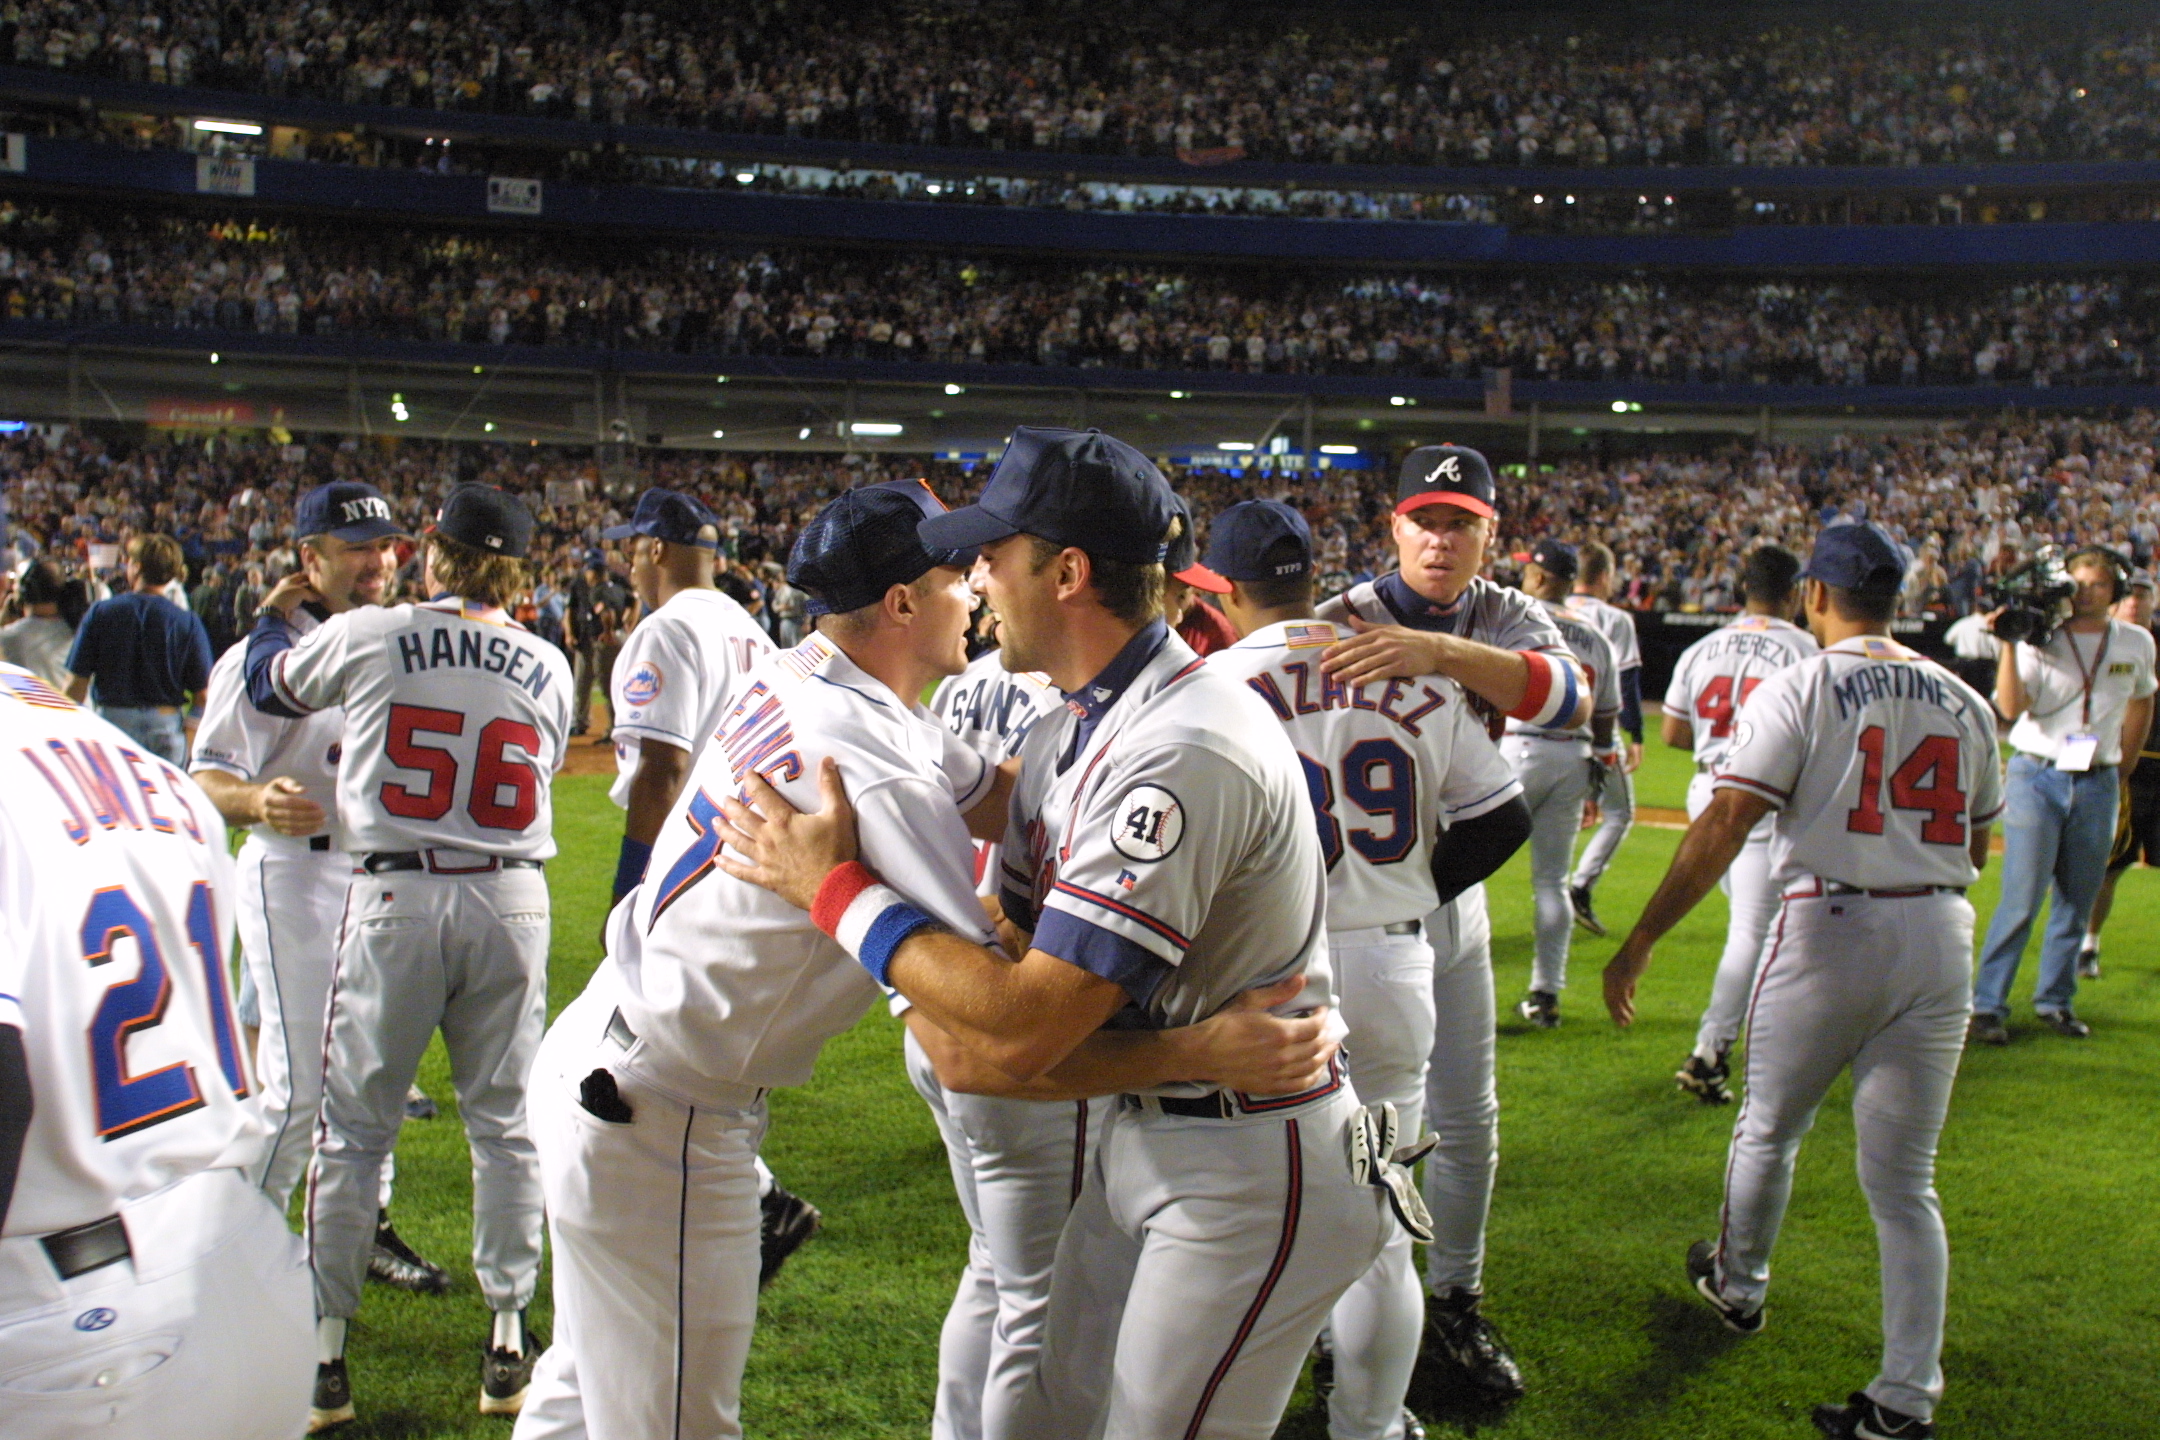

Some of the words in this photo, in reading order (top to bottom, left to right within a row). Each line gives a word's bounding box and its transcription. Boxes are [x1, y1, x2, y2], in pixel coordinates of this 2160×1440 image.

[398, 628, 552, 700] HANSEN
[1725, 632, 1784, 667] PEREZ
[379, 702, 541, 831] 56
[1127, 805, 1166, 844] 41
[1847, 724, 1967, 845] 14
[641, 784, 732, 938] 7
[80, 879, 250, 1143] 21
